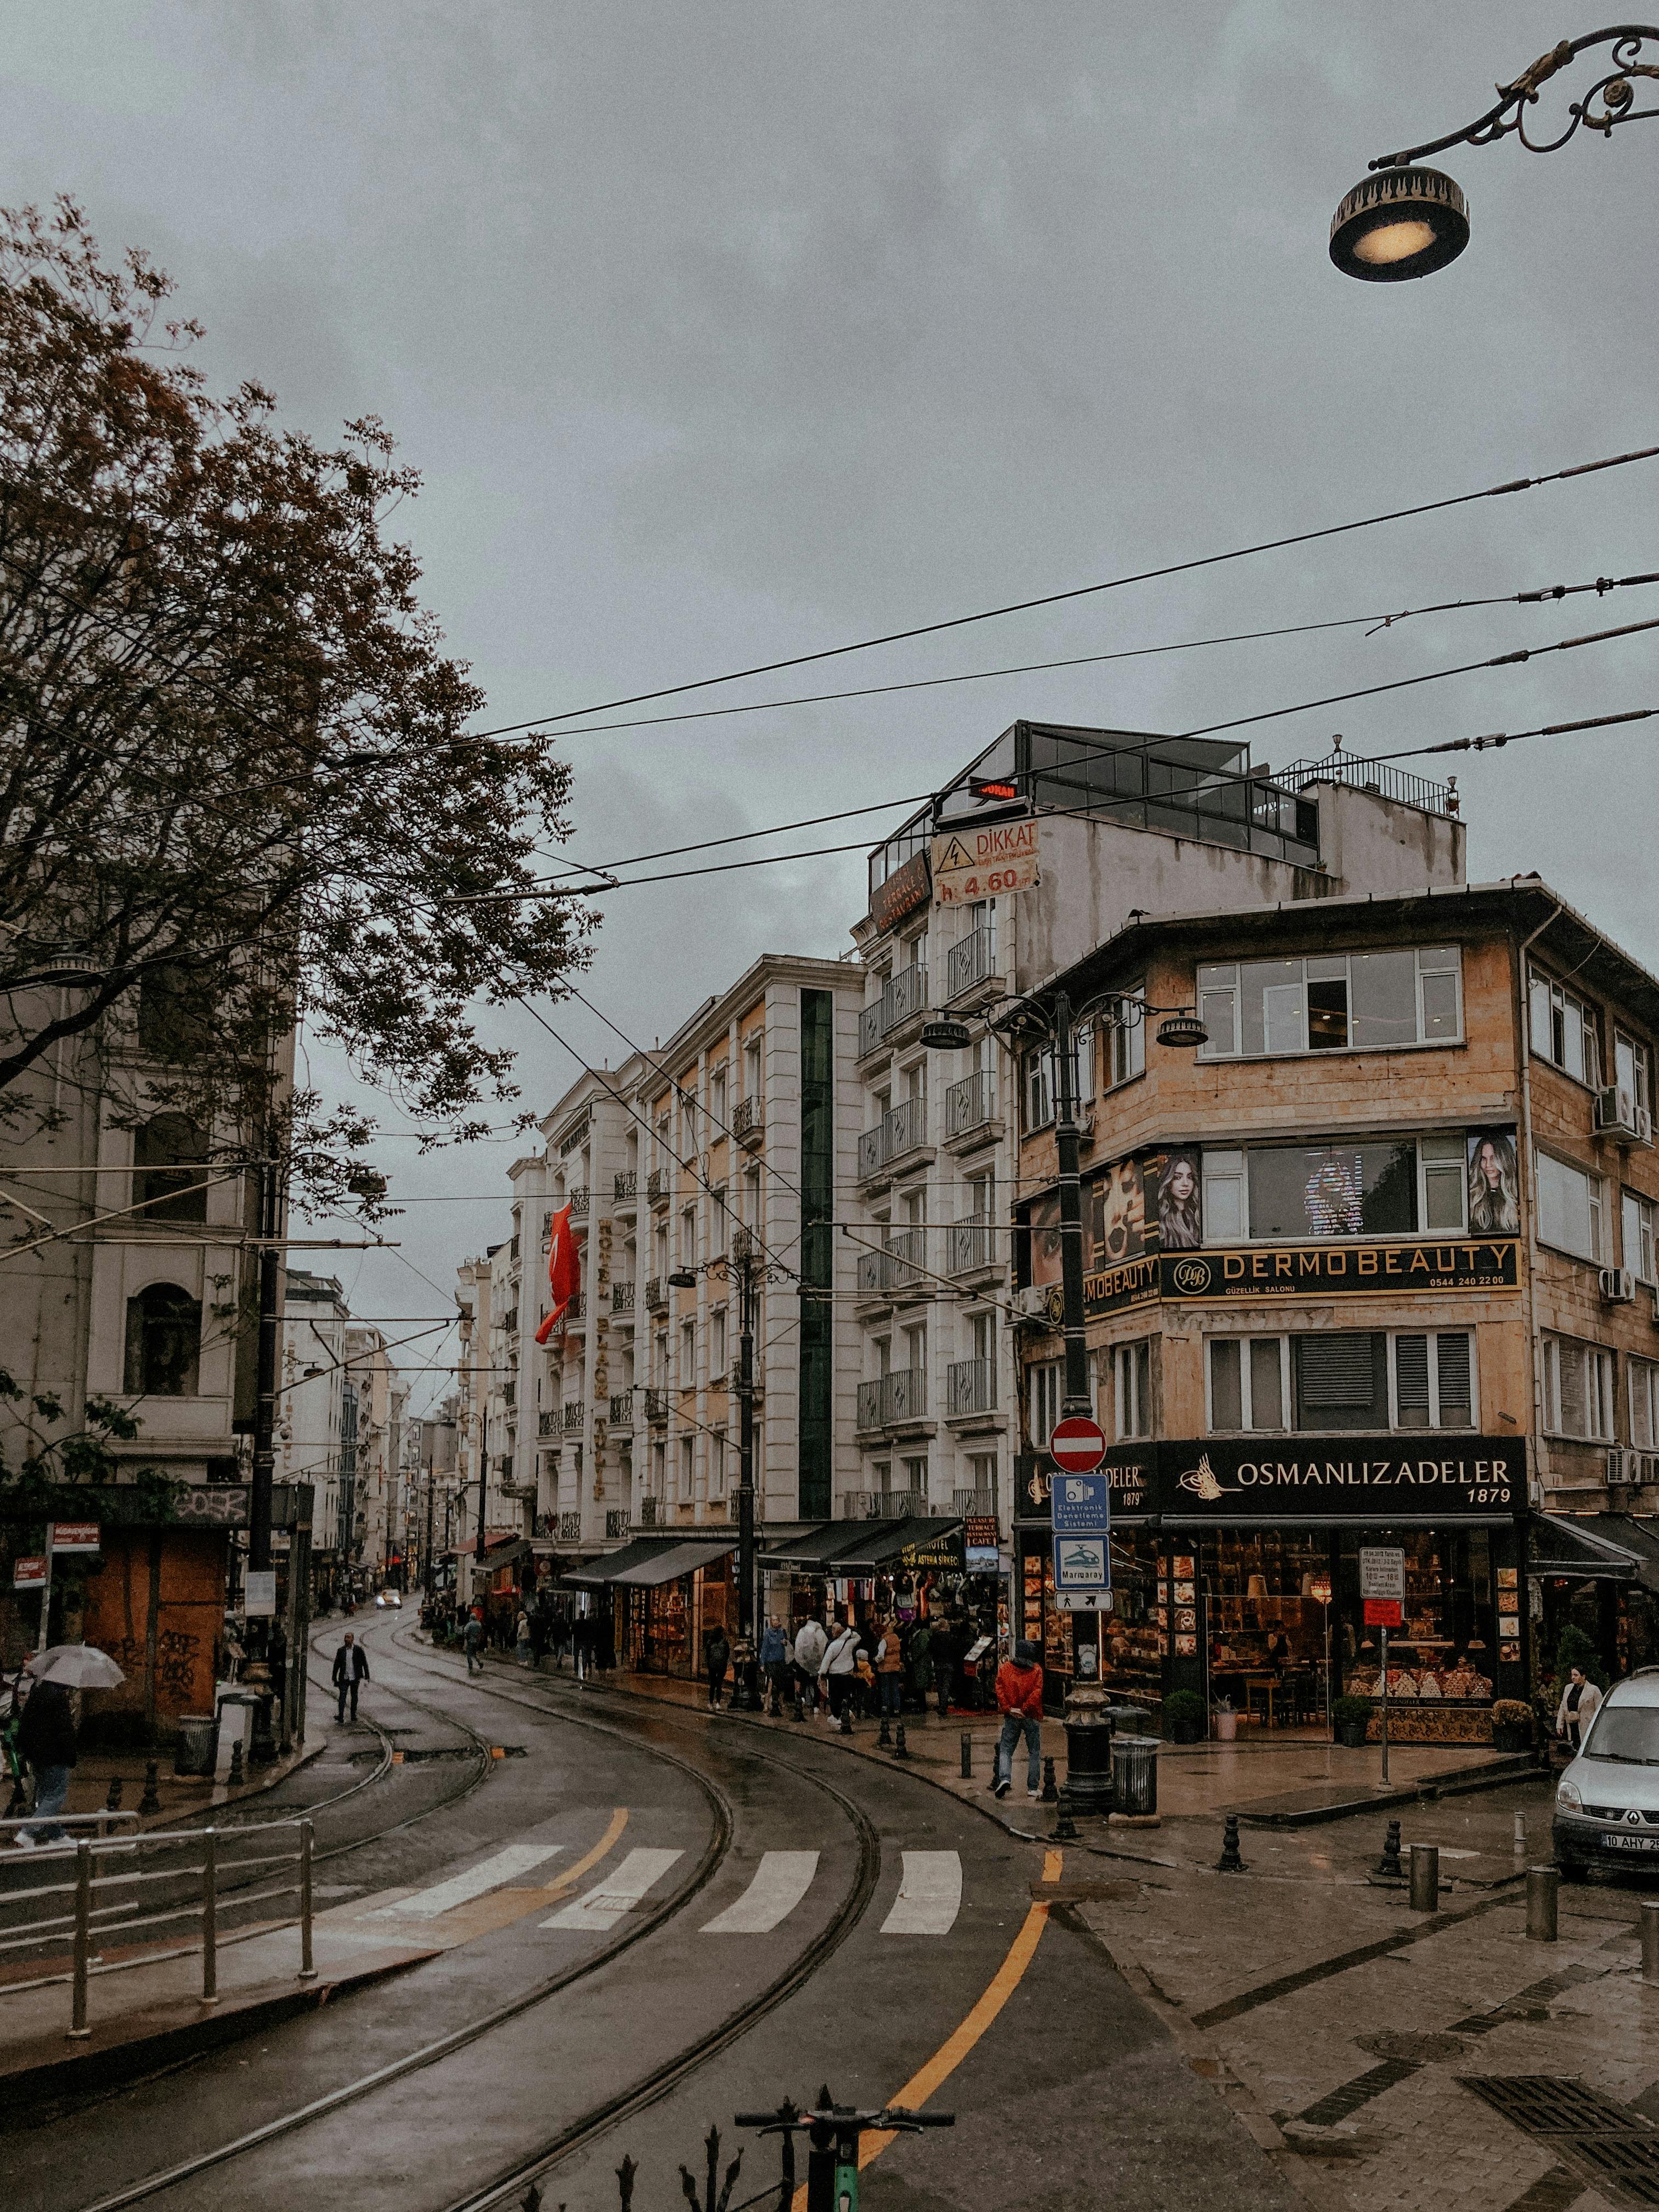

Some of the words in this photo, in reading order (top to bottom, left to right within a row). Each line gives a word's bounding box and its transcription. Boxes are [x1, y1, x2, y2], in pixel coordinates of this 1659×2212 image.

[977, 823, 1035, 855] DİKKAT
[1430, 1278, 1454, 1287] 0544
[1459, 1277, 1476, 1286] 240
[1225, 1285, 1260, 1295] GÜZELLİK
[1237, 1460, 1511, 1486] OSMANLIZADELER
[1123, 1492, 1140, 1506] 1879
[1467, 1488, 1510, 1503] 1879
[1062, 1571, 1103, 1580] Marmaray
[1608, 1836, 1617, 1846] 10
[1622, 1837, 1644, 1848] AHY
